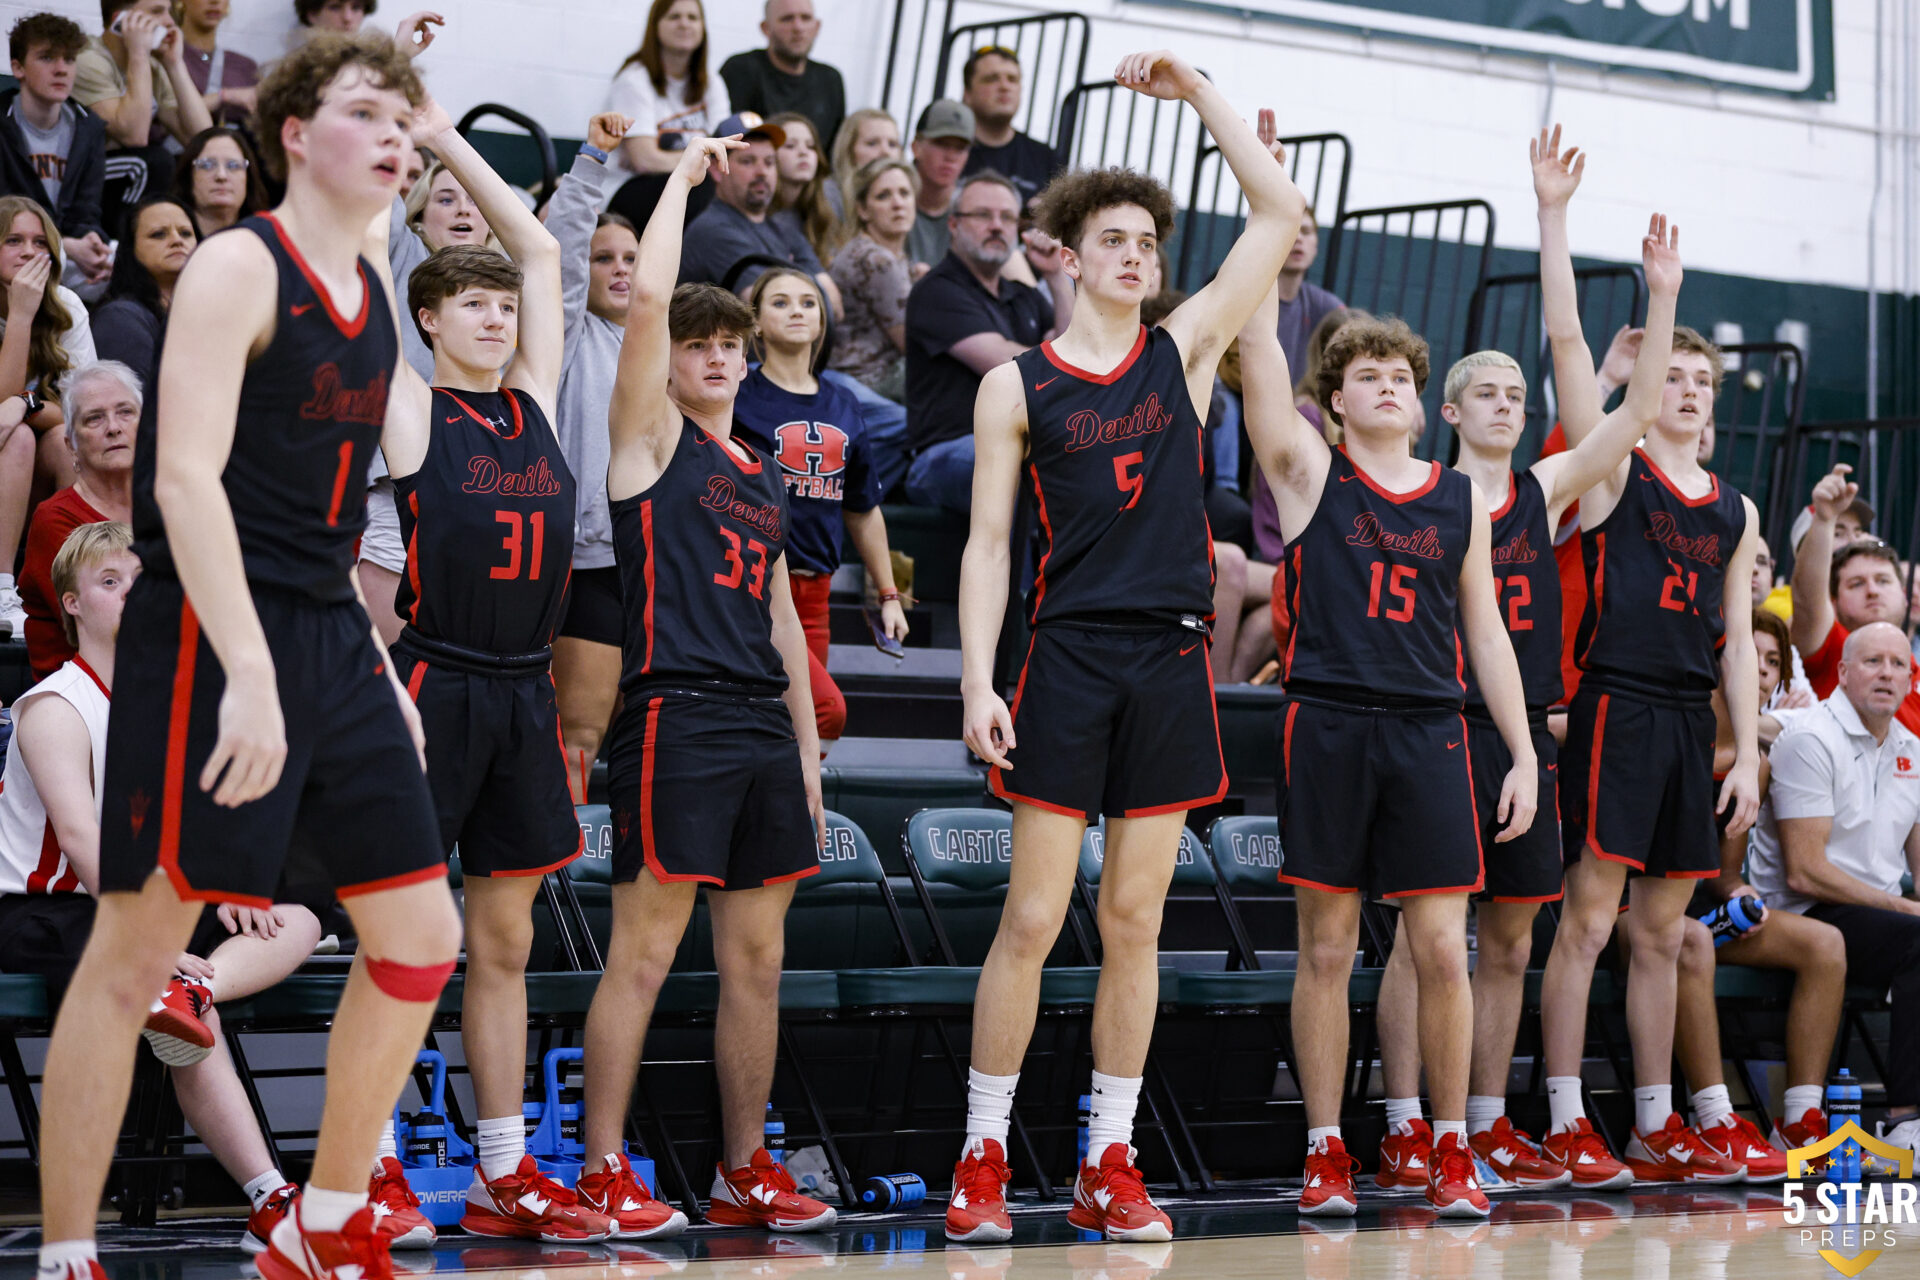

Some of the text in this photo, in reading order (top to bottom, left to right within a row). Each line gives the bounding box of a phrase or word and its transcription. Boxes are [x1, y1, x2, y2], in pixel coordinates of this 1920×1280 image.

[774, 420, 849, 476] H
[1065, 392, 1173, 453] Devils
[326, 440, 354, 528] 1
[462, 455, 561, 497] Devils
[1112, 450, 1144, 512] 5
[699, 475, 782, 542] Devils
[1345, 511, 1445, 560] Devils
[1644, 511, 1722, 567] Devils
[489, 509, 545, 581] 31
[713, 524, 768, 601] 33
[1366, 560, 1419, 624] 15
[1659, 556, 1700, 617] 21
